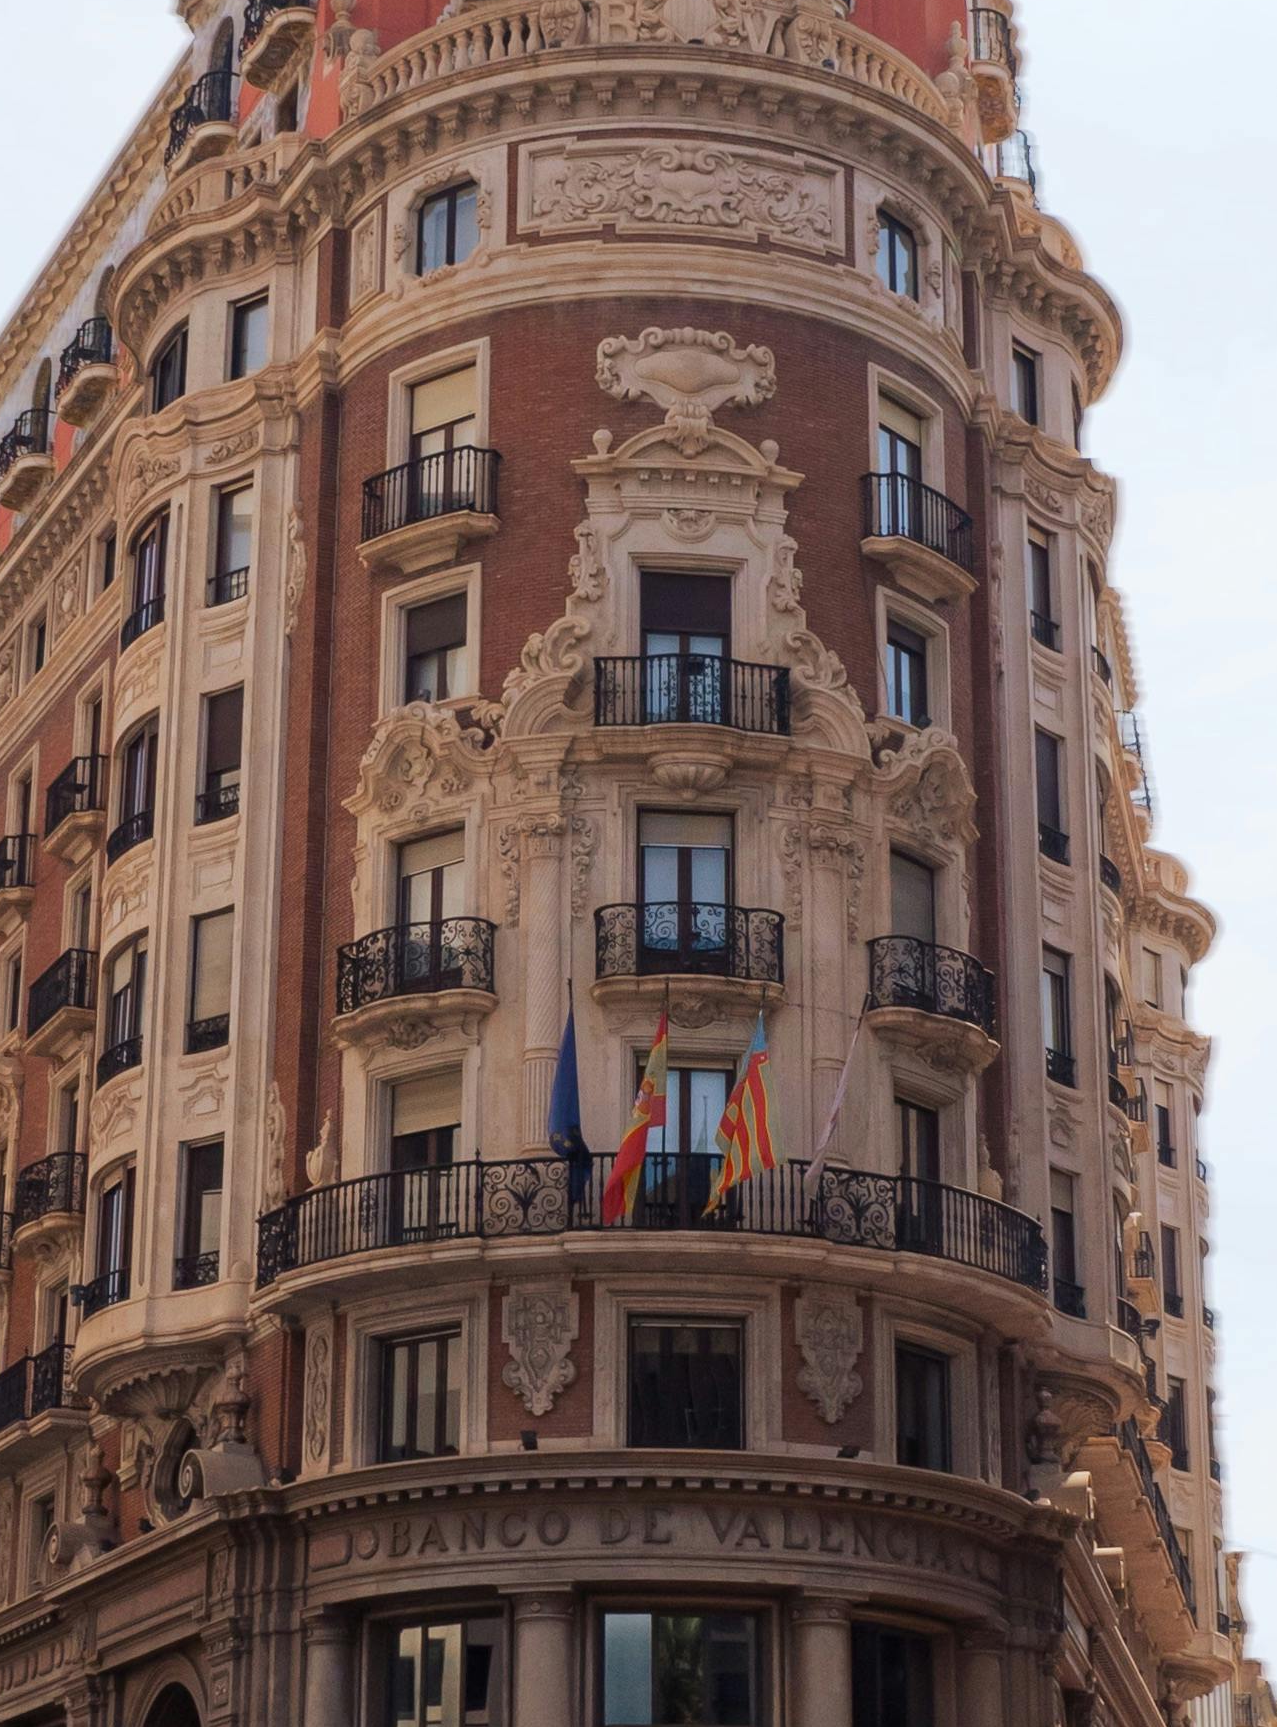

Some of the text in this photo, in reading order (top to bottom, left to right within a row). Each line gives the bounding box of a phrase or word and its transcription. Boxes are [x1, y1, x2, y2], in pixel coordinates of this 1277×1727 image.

[387, 1505, 956, 1569] BANCO DE VALENCIA
